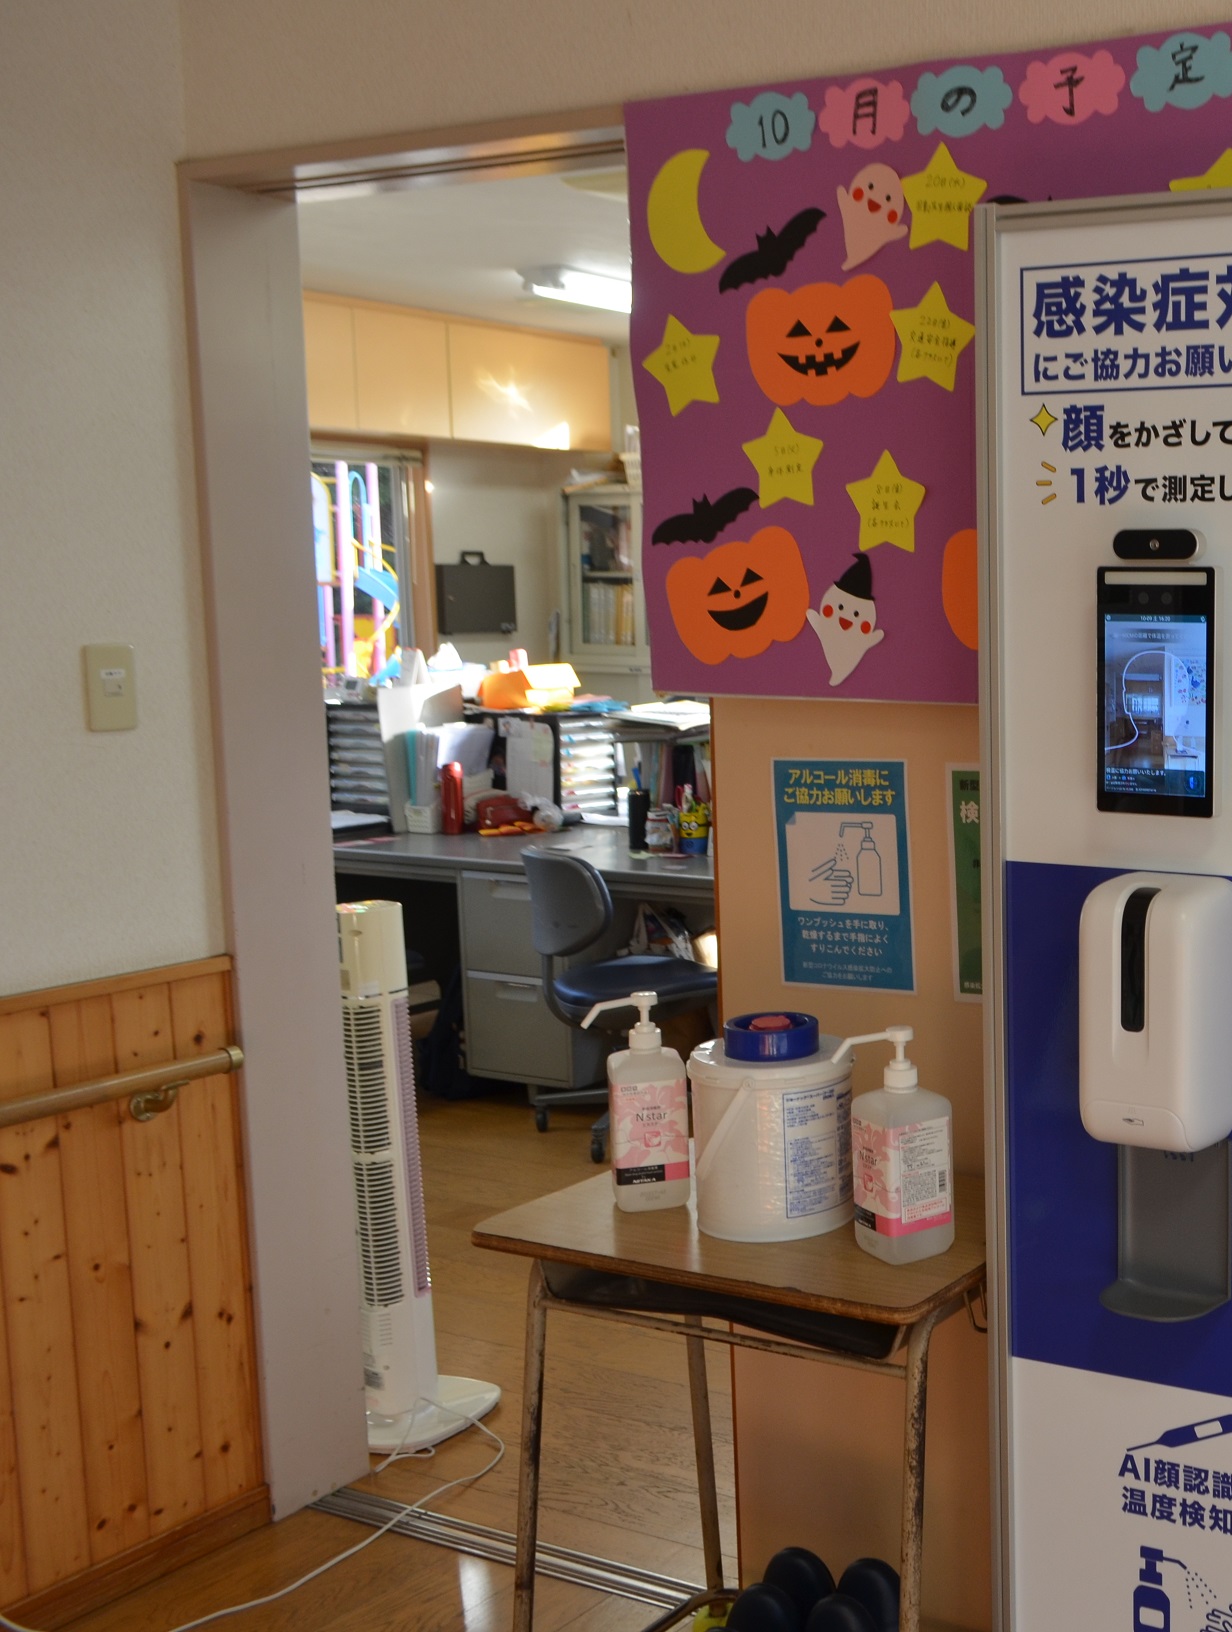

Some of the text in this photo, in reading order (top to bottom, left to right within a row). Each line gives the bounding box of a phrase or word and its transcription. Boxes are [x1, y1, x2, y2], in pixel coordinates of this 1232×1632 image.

[757, 43, 1206, 149] 10月の予定
[788, 769, 889, 787] アルコール消毒に
[784, 787, 895, 806] ご協力お願いします
[959, 800, 979, 824] 検
[810, 943, 882, 957] すりこんでください
